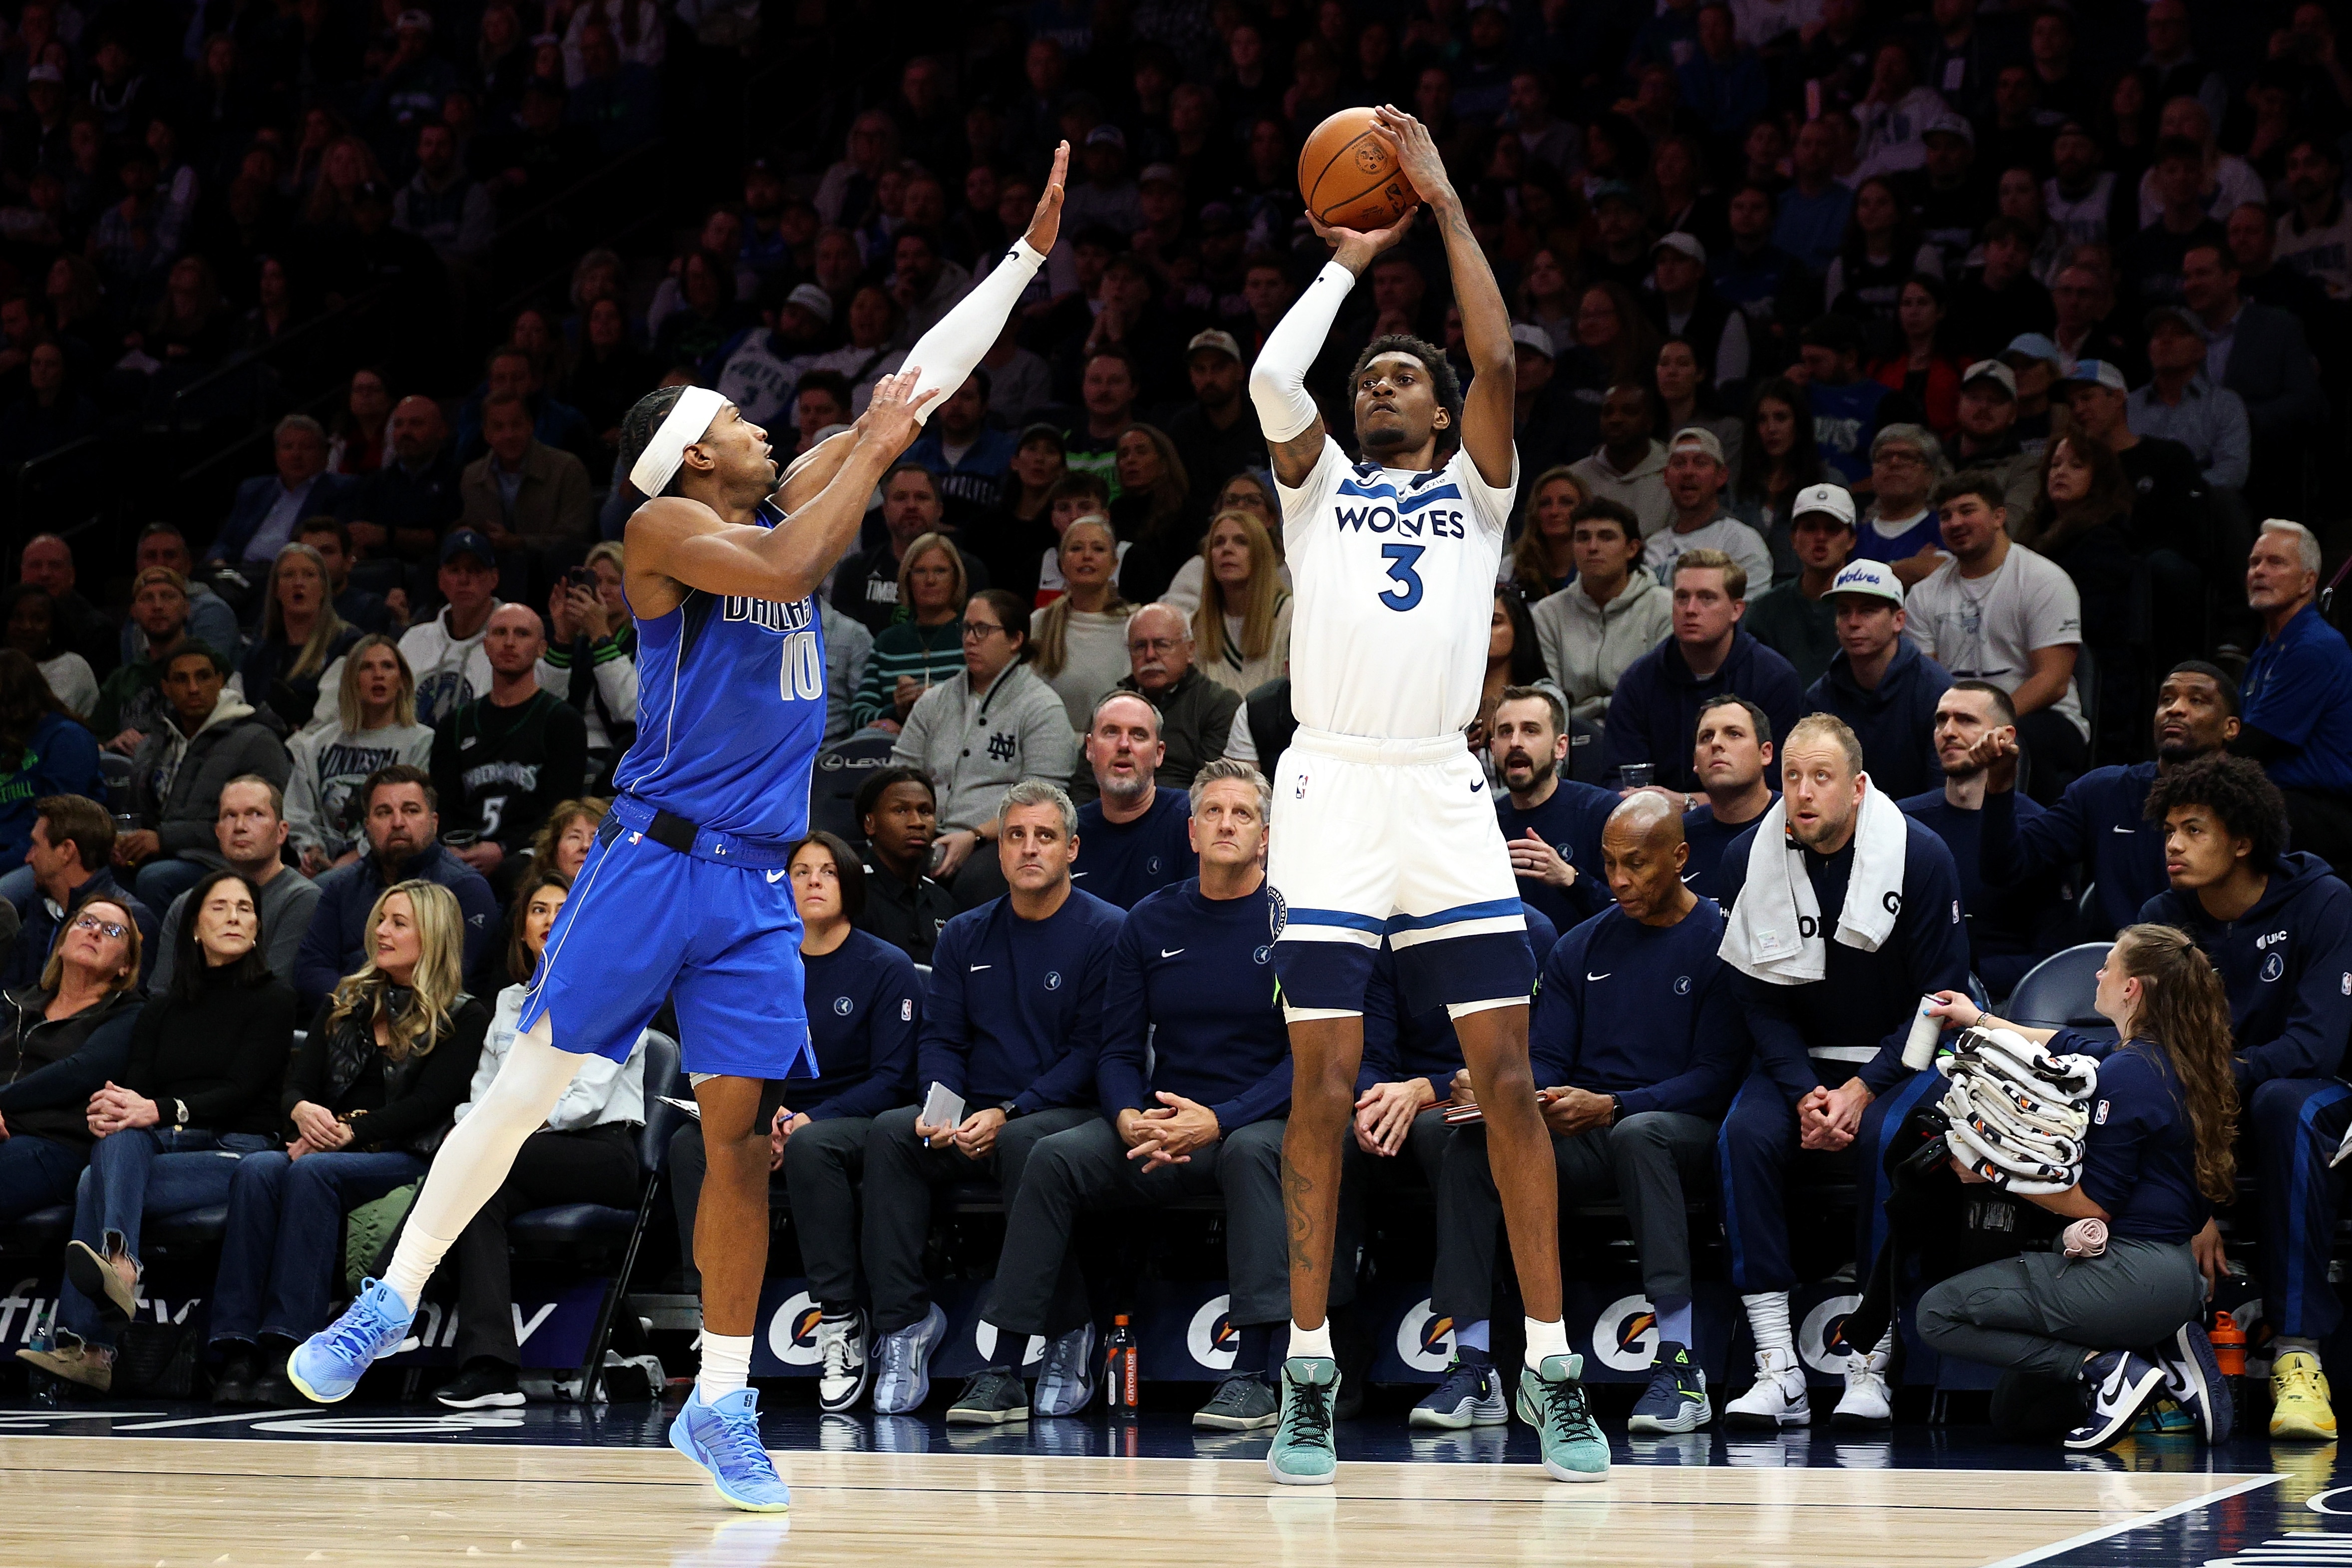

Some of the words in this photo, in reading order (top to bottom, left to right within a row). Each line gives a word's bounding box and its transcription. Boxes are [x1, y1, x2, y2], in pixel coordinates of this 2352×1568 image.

[1335, 506, 1465, 540] WOLVES
[1378, 543, 1426, 612] 3
[780, 631, 823, 701] 10
[478, 795, 509, 838] 5
[2266, 930, 2287, 944] UHC
[1127, 1353, 1137, 1402] GATORADE
